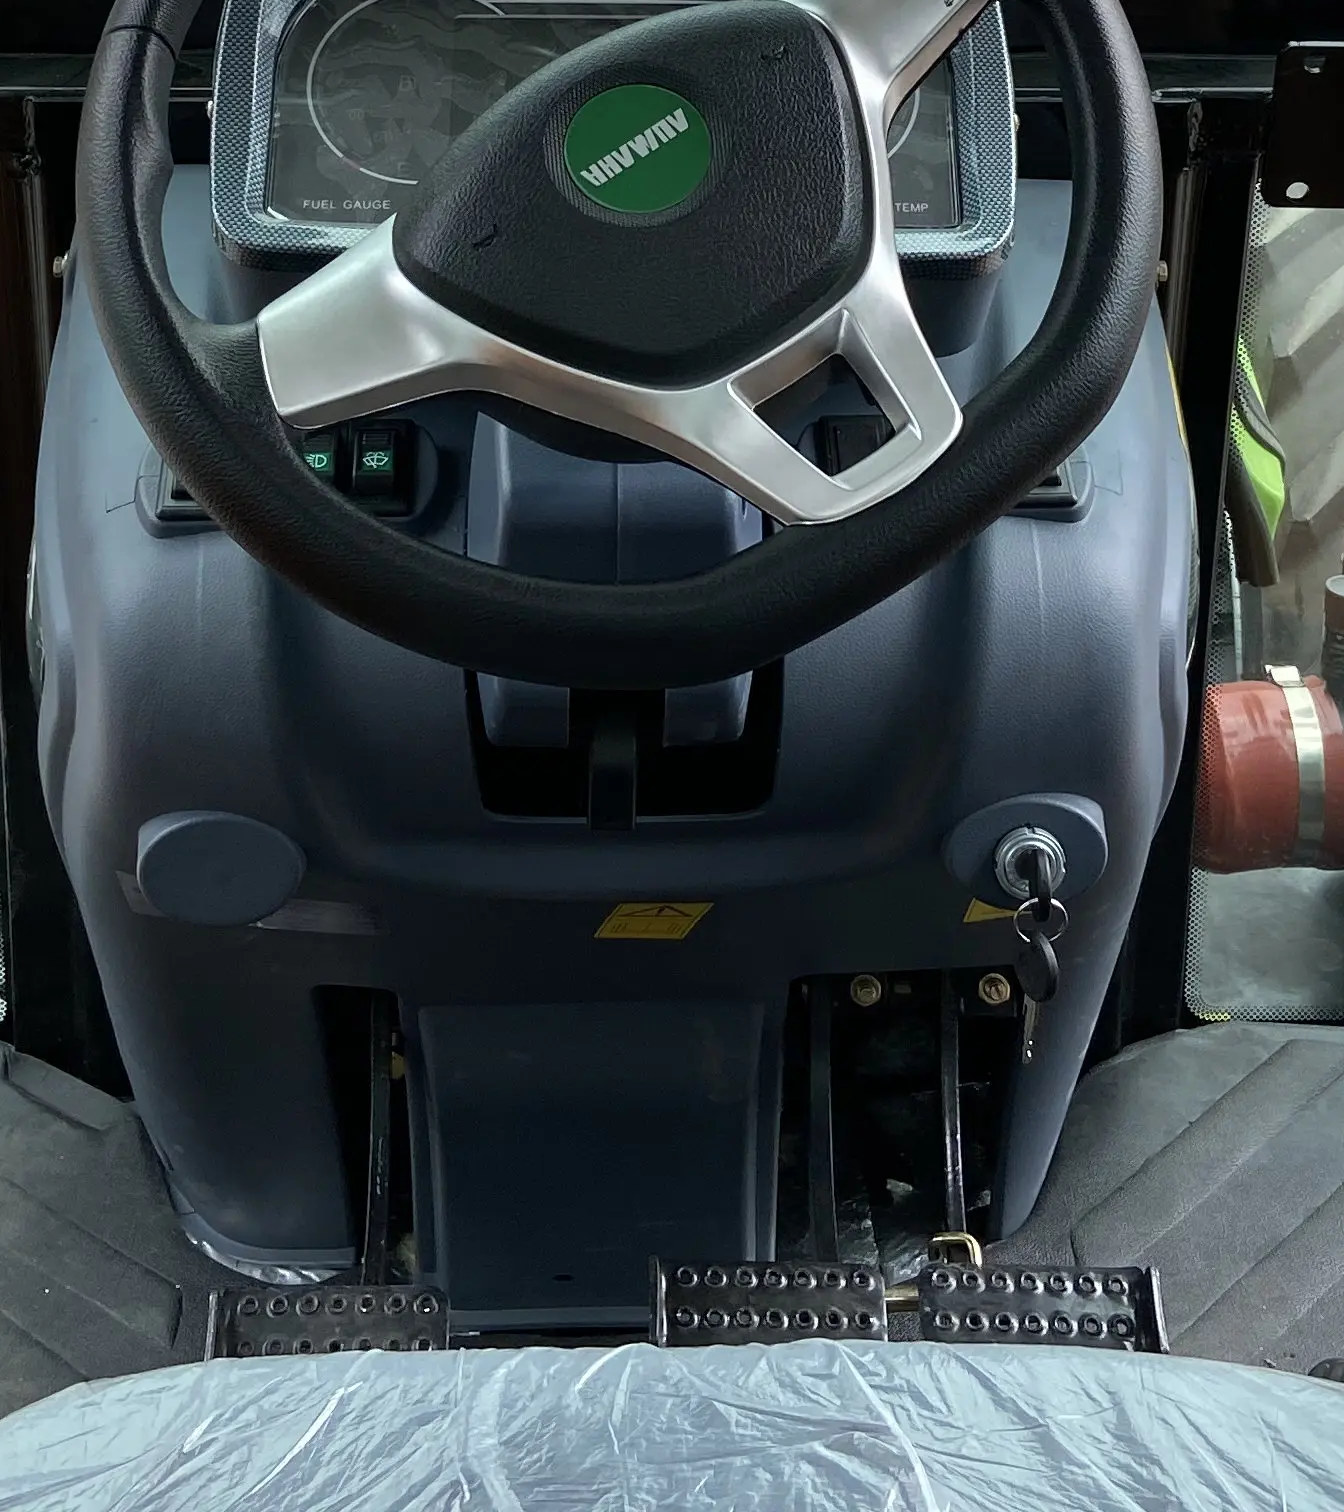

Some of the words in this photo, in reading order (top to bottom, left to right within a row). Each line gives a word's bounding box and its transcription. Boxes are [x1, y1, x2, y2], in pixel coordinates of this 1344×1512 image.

[302, 199, 337, 210] FUEL
[342, 199, 391, 210] GAUGE
[894, 202, 929, 213] TEMP
